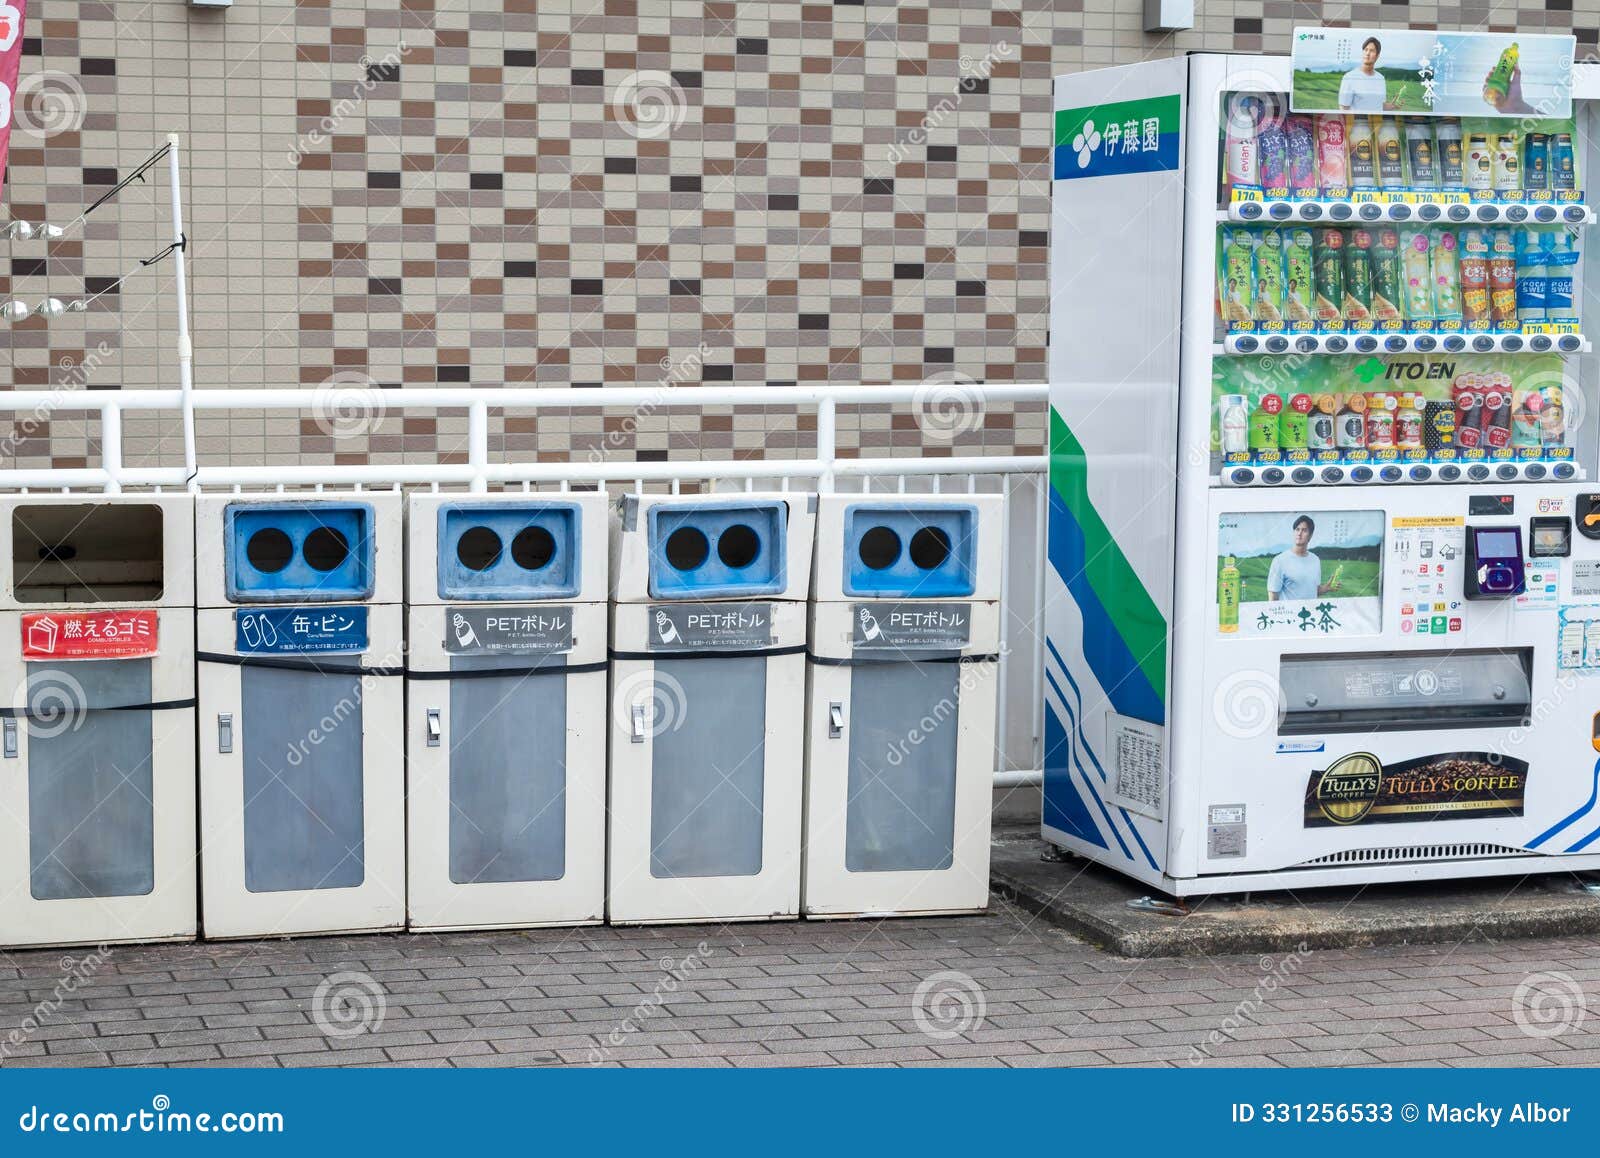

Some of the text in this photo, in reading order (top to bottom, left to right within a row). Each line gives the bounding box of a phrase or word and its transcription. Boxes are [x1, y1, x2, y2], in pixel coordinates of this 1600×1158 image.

[1103, 117, 1159, 157] 伊藤園
[1241, 145, 1249, 172] evian
[1385, 362, 1456, 380] ITO EN
[292, 614, 355, 634] 缶・ビン
[486, 614, 566, 632] PETボトル
[688, 611, 765, 629] PETボトル
[890, 610, 965, 627] PETボトル
[64, 618, 150, 639] 燃えるゴミ
[1454, 775, 1519, 791] COFFEE
[1331, 791, 1365, 799] COFFEE
